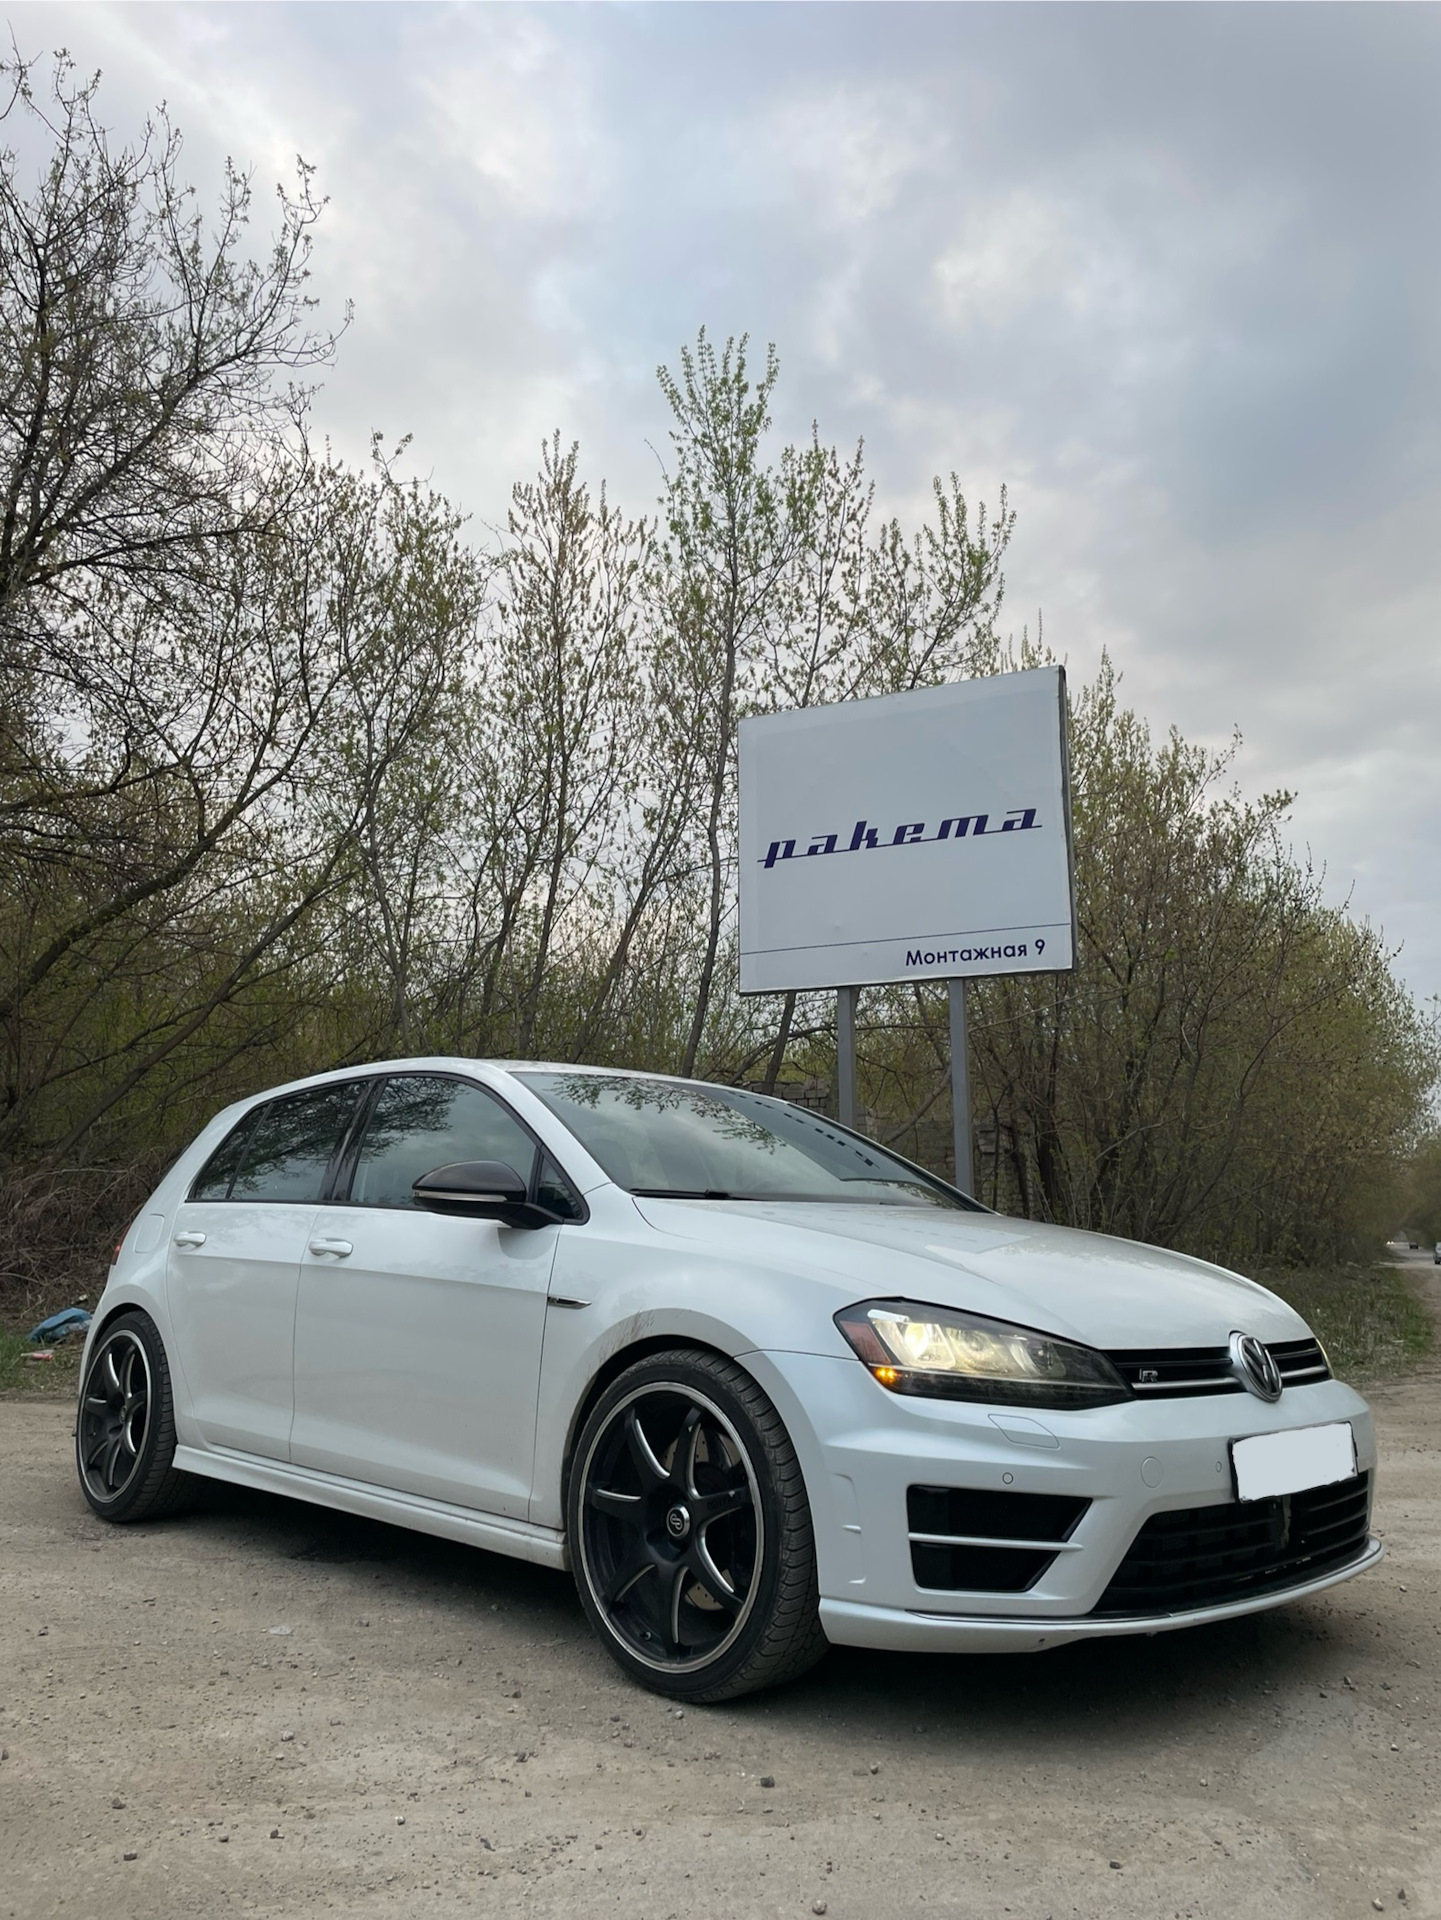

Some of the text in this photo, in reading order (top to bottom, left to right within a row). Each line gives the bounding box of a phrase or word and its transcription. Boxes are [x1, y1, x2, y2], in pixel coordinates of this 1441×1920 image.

[757, 808, 1043, 869] ракета
[905, 938, 1046, 966] Монтажная 9
